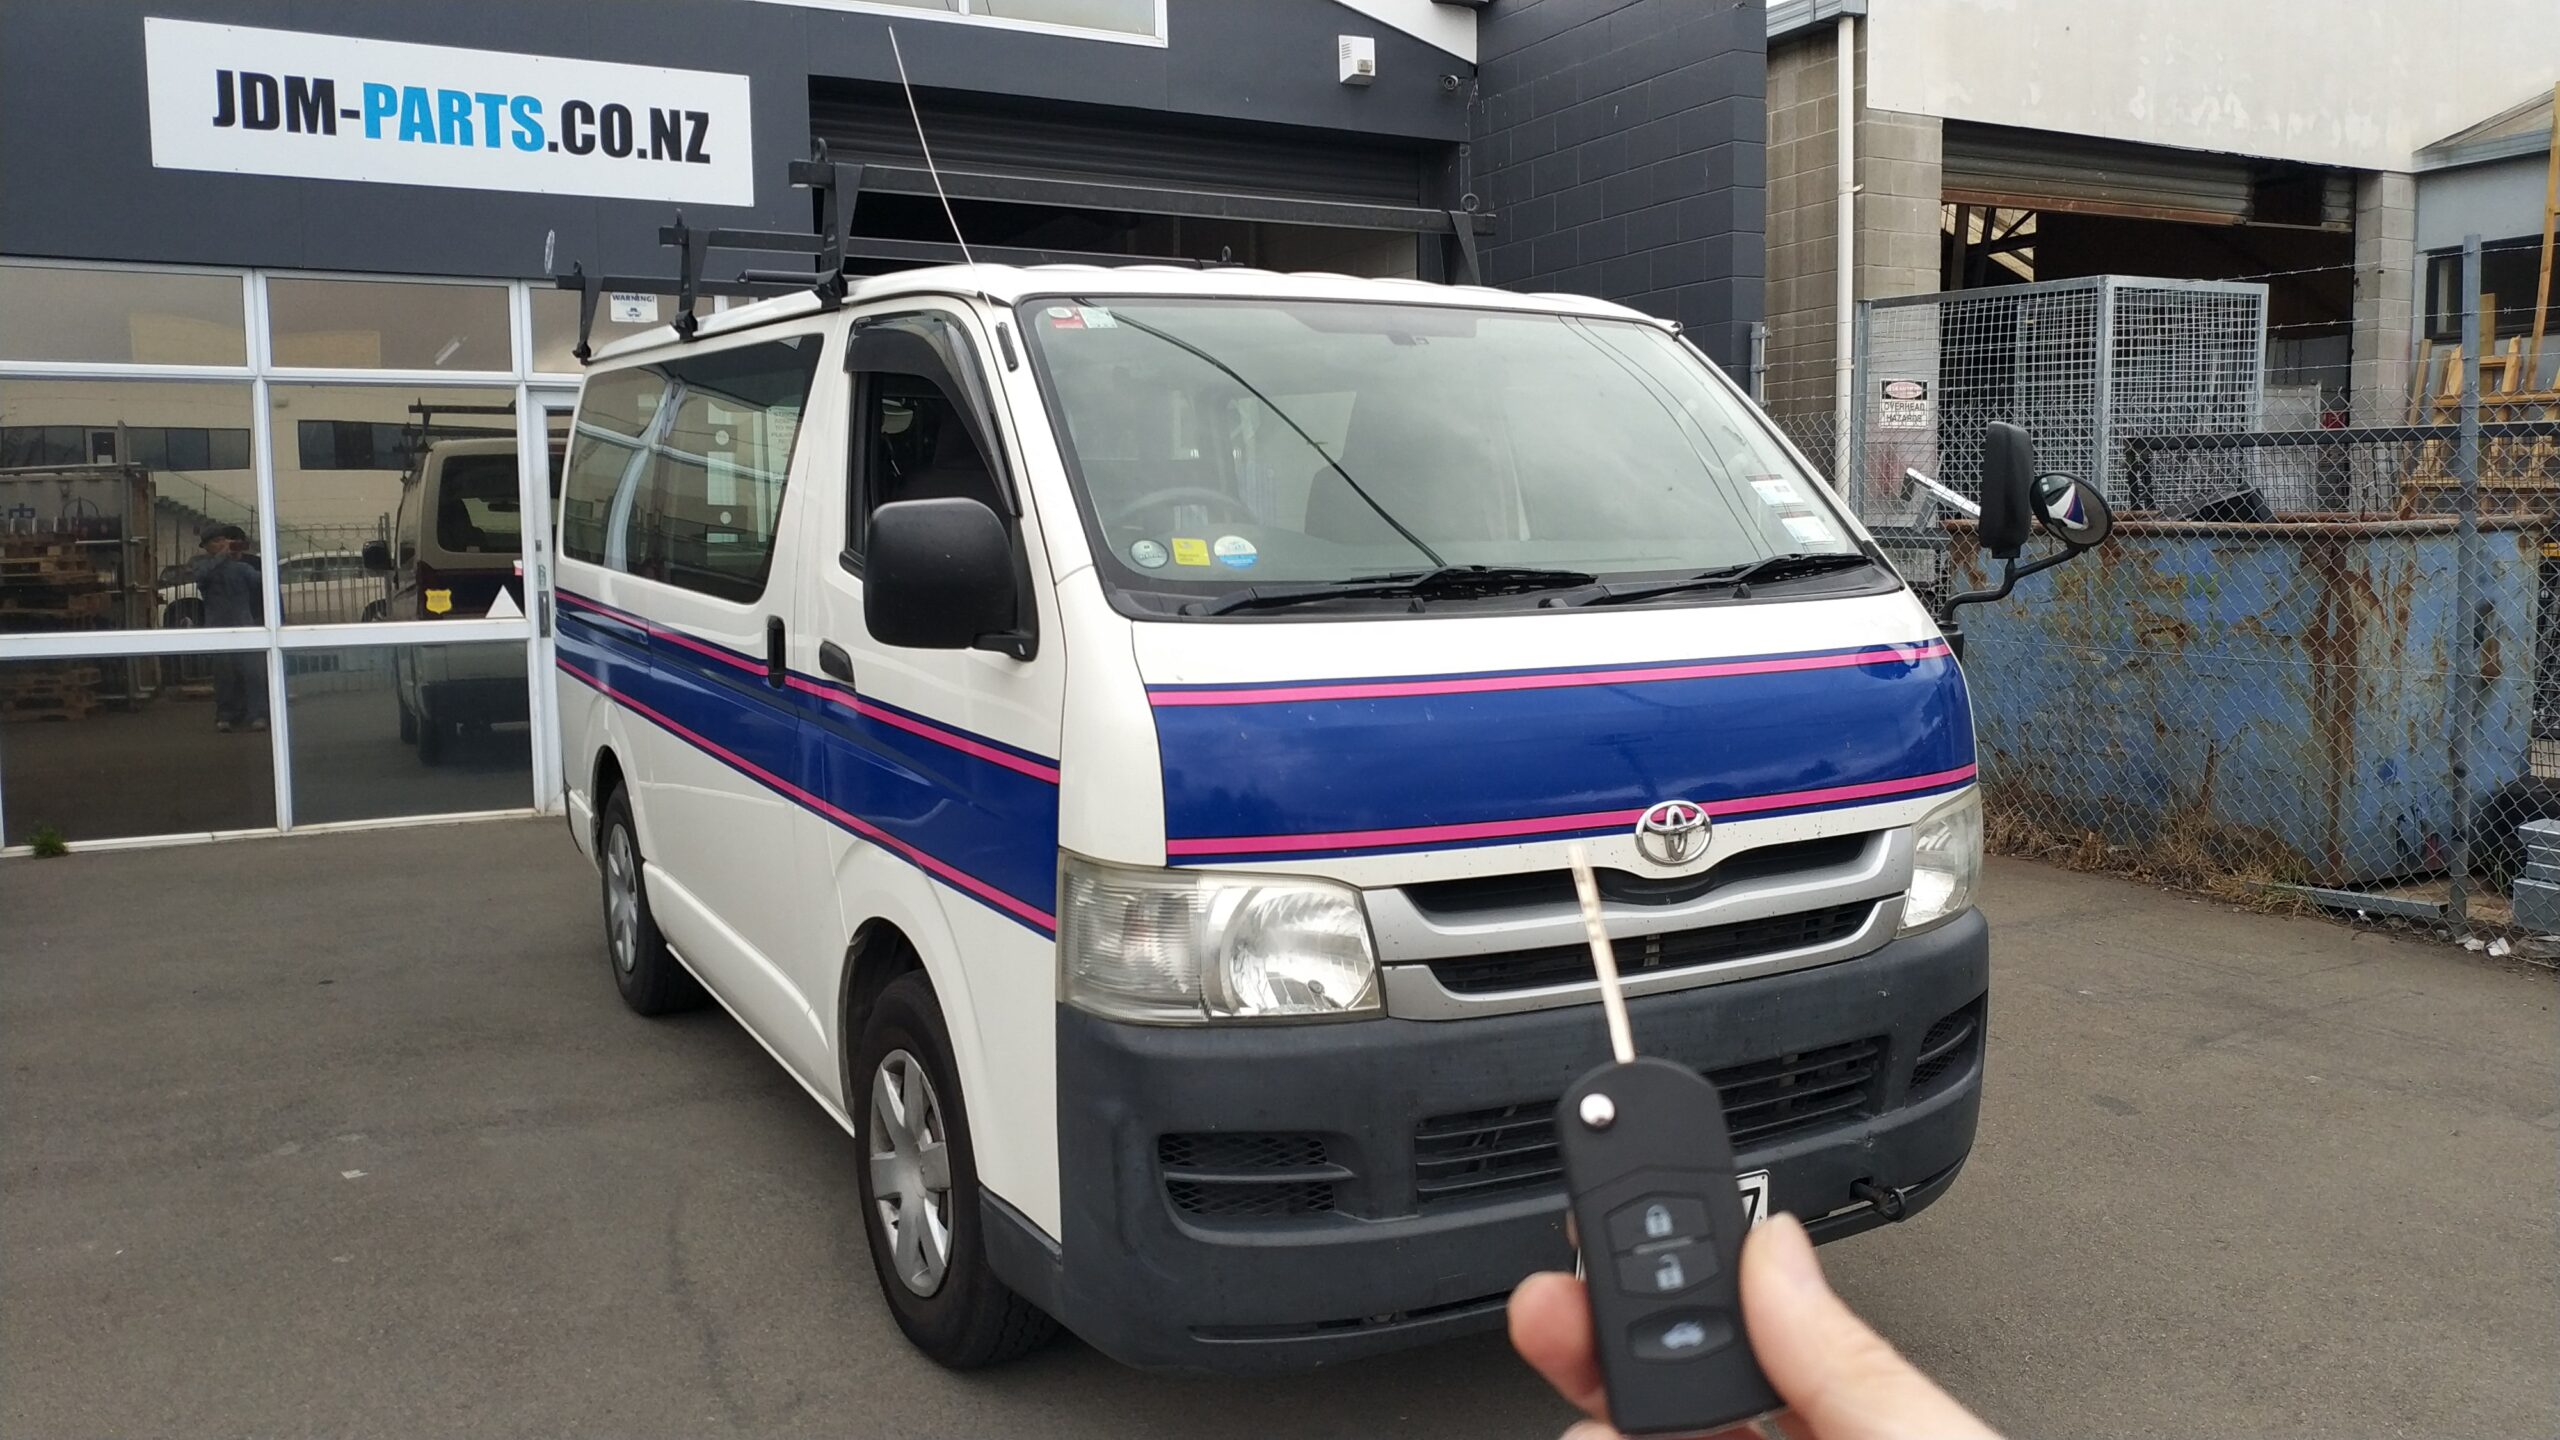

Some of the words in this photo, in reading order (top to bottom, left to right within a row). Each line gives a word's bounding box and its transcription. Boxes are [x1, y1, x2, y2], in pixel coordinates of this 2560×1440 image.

[212, 69, 711, 165] JDM-PARTS.CO.NZ
[612, 294, 655, 303] WARNING!
[1884, 402, 1925, 411] OVERHEAD
